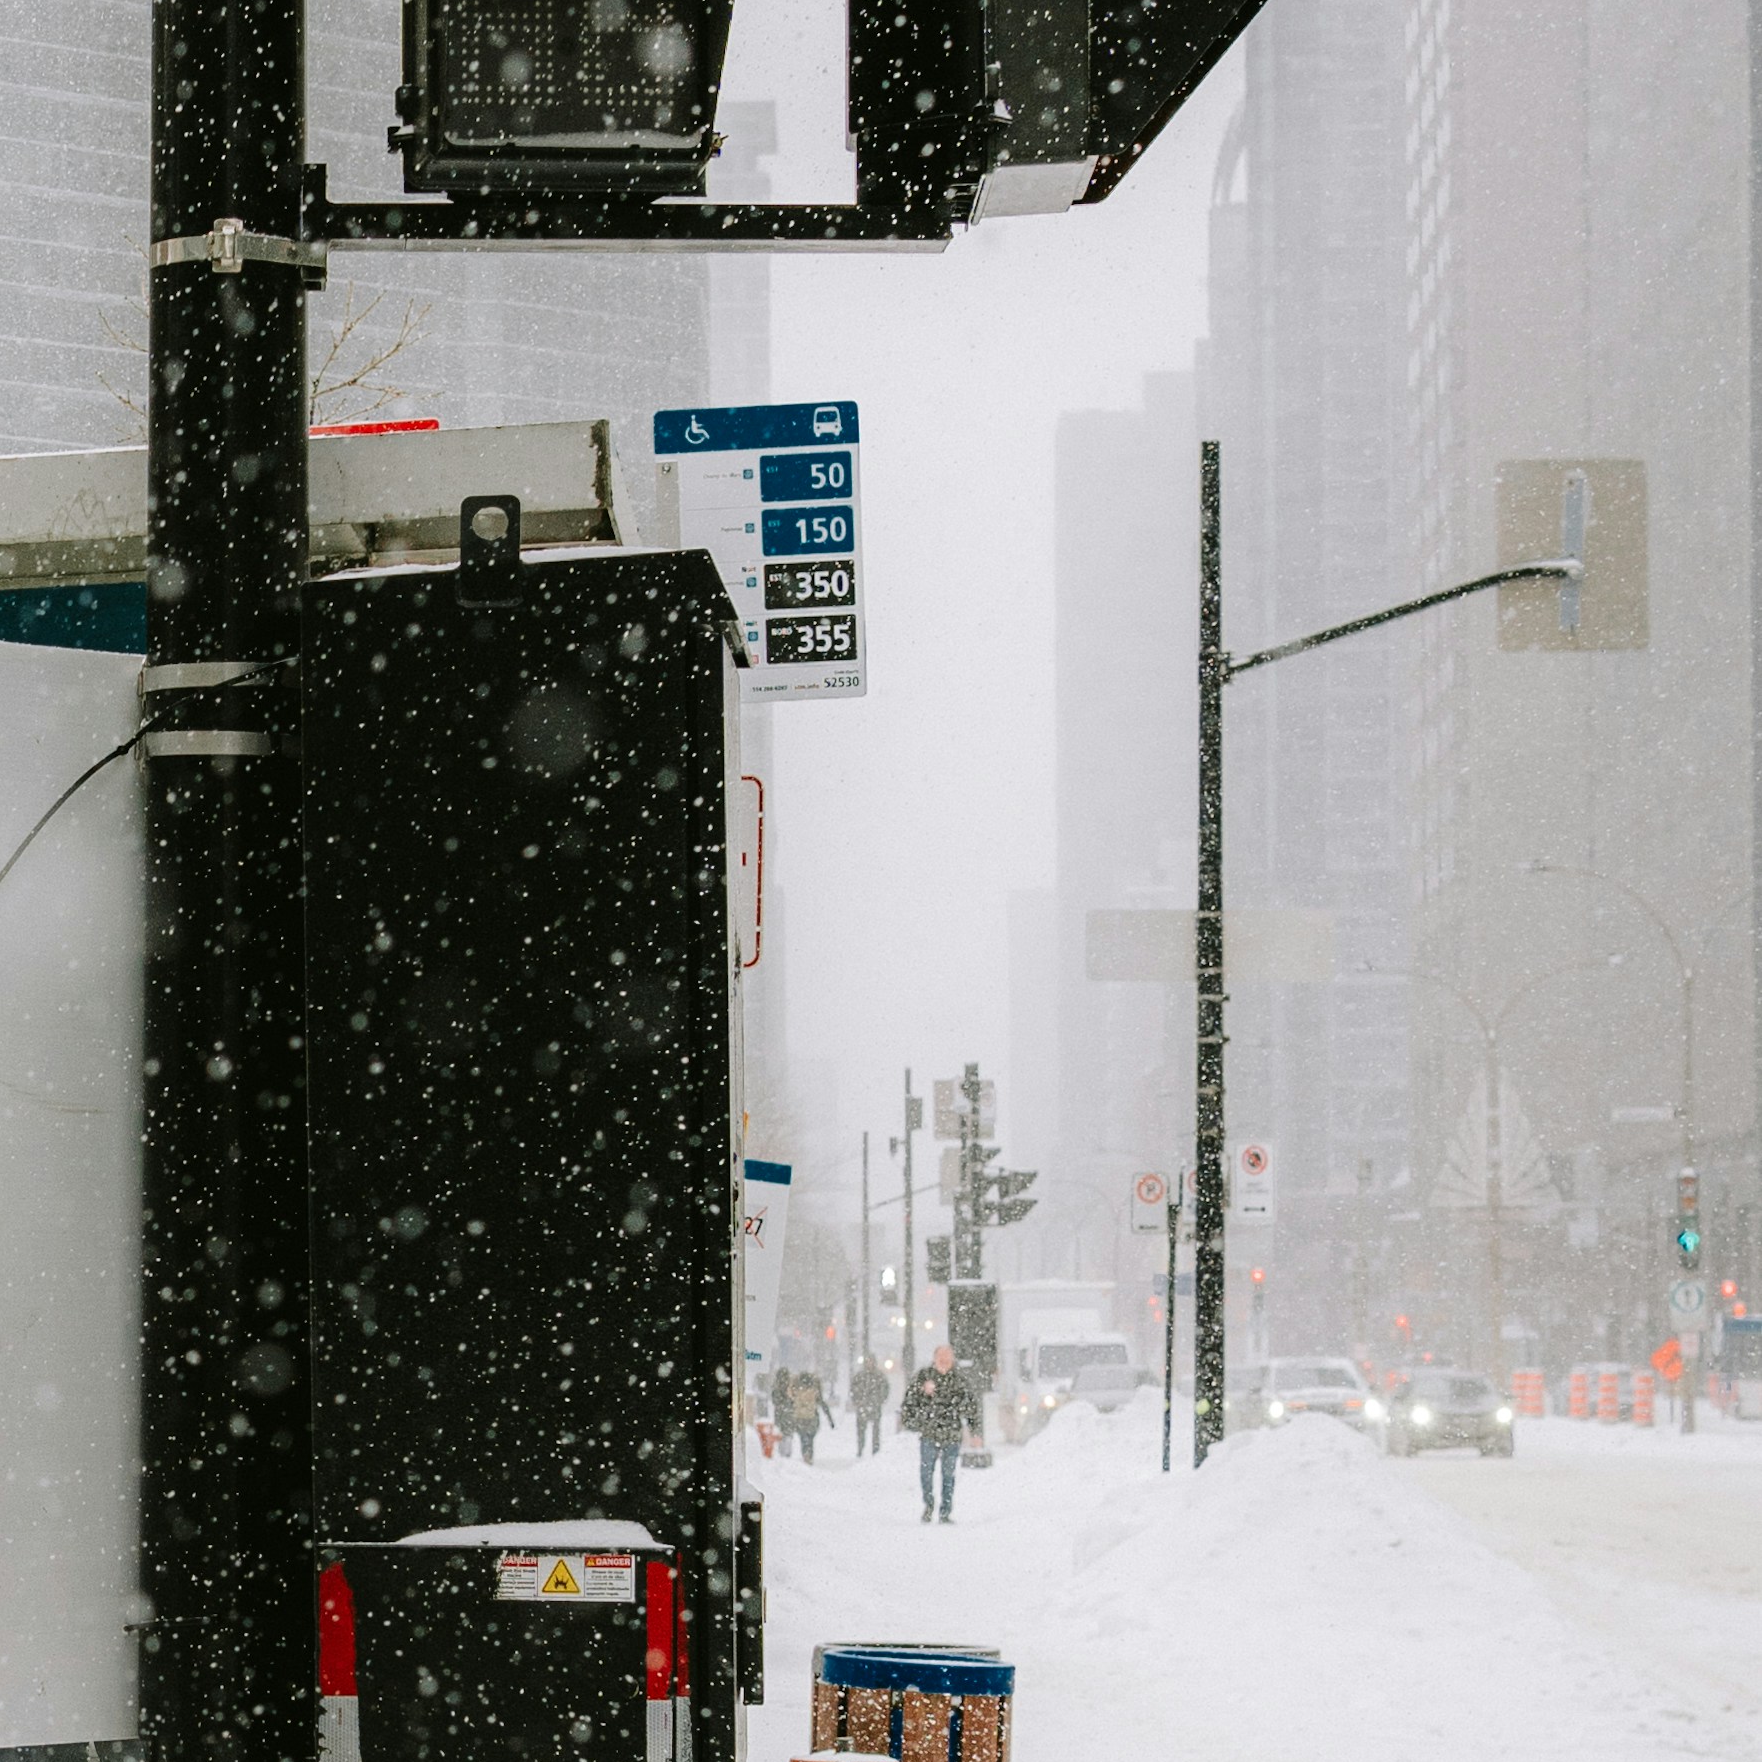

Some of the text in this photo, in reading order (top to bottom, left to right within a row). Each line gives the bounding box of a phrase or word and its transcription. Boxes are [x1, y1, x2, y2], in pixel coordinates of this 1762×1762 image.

[810, 462, 845, 490] 50
[767, 520, 781, 528] EST
[795, 516, 847, 544] 150
[769, 573, 783, 582] EST
[796, 570, 850, 600] 350
[798, 624, 851, 654] 355
[824, 676, 860, 689] 52530
[502, 1556, 538, 1565] DANGER
[595, 1556, 631, 1566] DANGER
